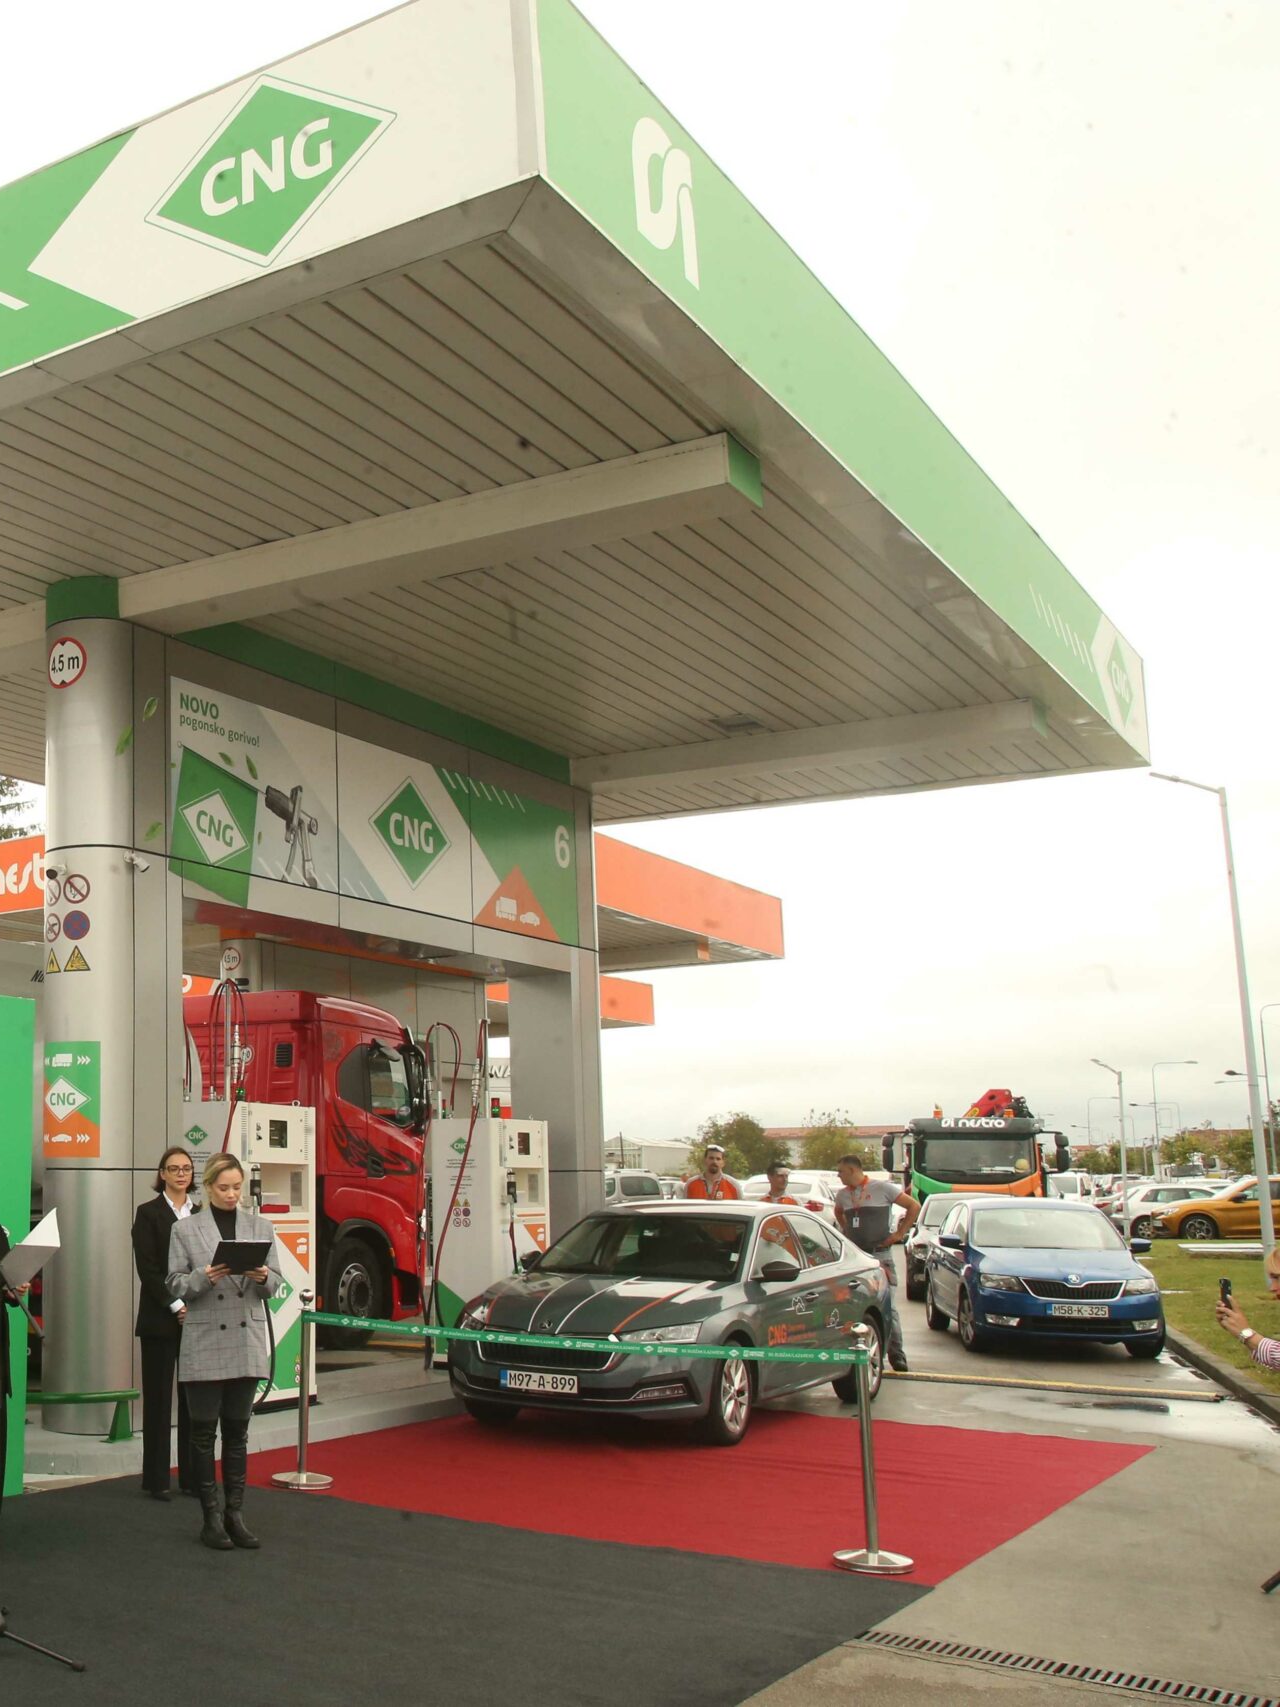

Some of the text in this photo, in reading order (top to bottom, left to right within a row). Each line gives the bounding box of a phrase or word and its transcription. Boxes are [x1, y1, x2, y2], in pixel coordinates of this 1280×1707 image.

[199, 116, 334, 217] CNG
[51, 654, 80, 673] 4.5 m
[179, 692, 219, 719] NOVO
[179, 714, 260, 747] pogonsko gorivo!
[196, 809, 234, 847] CNG
[389, 812, 434, 854] CNG
[554, 825, 570, 869] 6
[49, 1092, 76, 1106] CNG
[958, 1117, 1006, 1129] nestro
[188, 1131, 204, 1139] CNG
[1053, 1305, 1107, 1316] M58-K-325
[509, 1371, 576, 1391] M97-A-899
